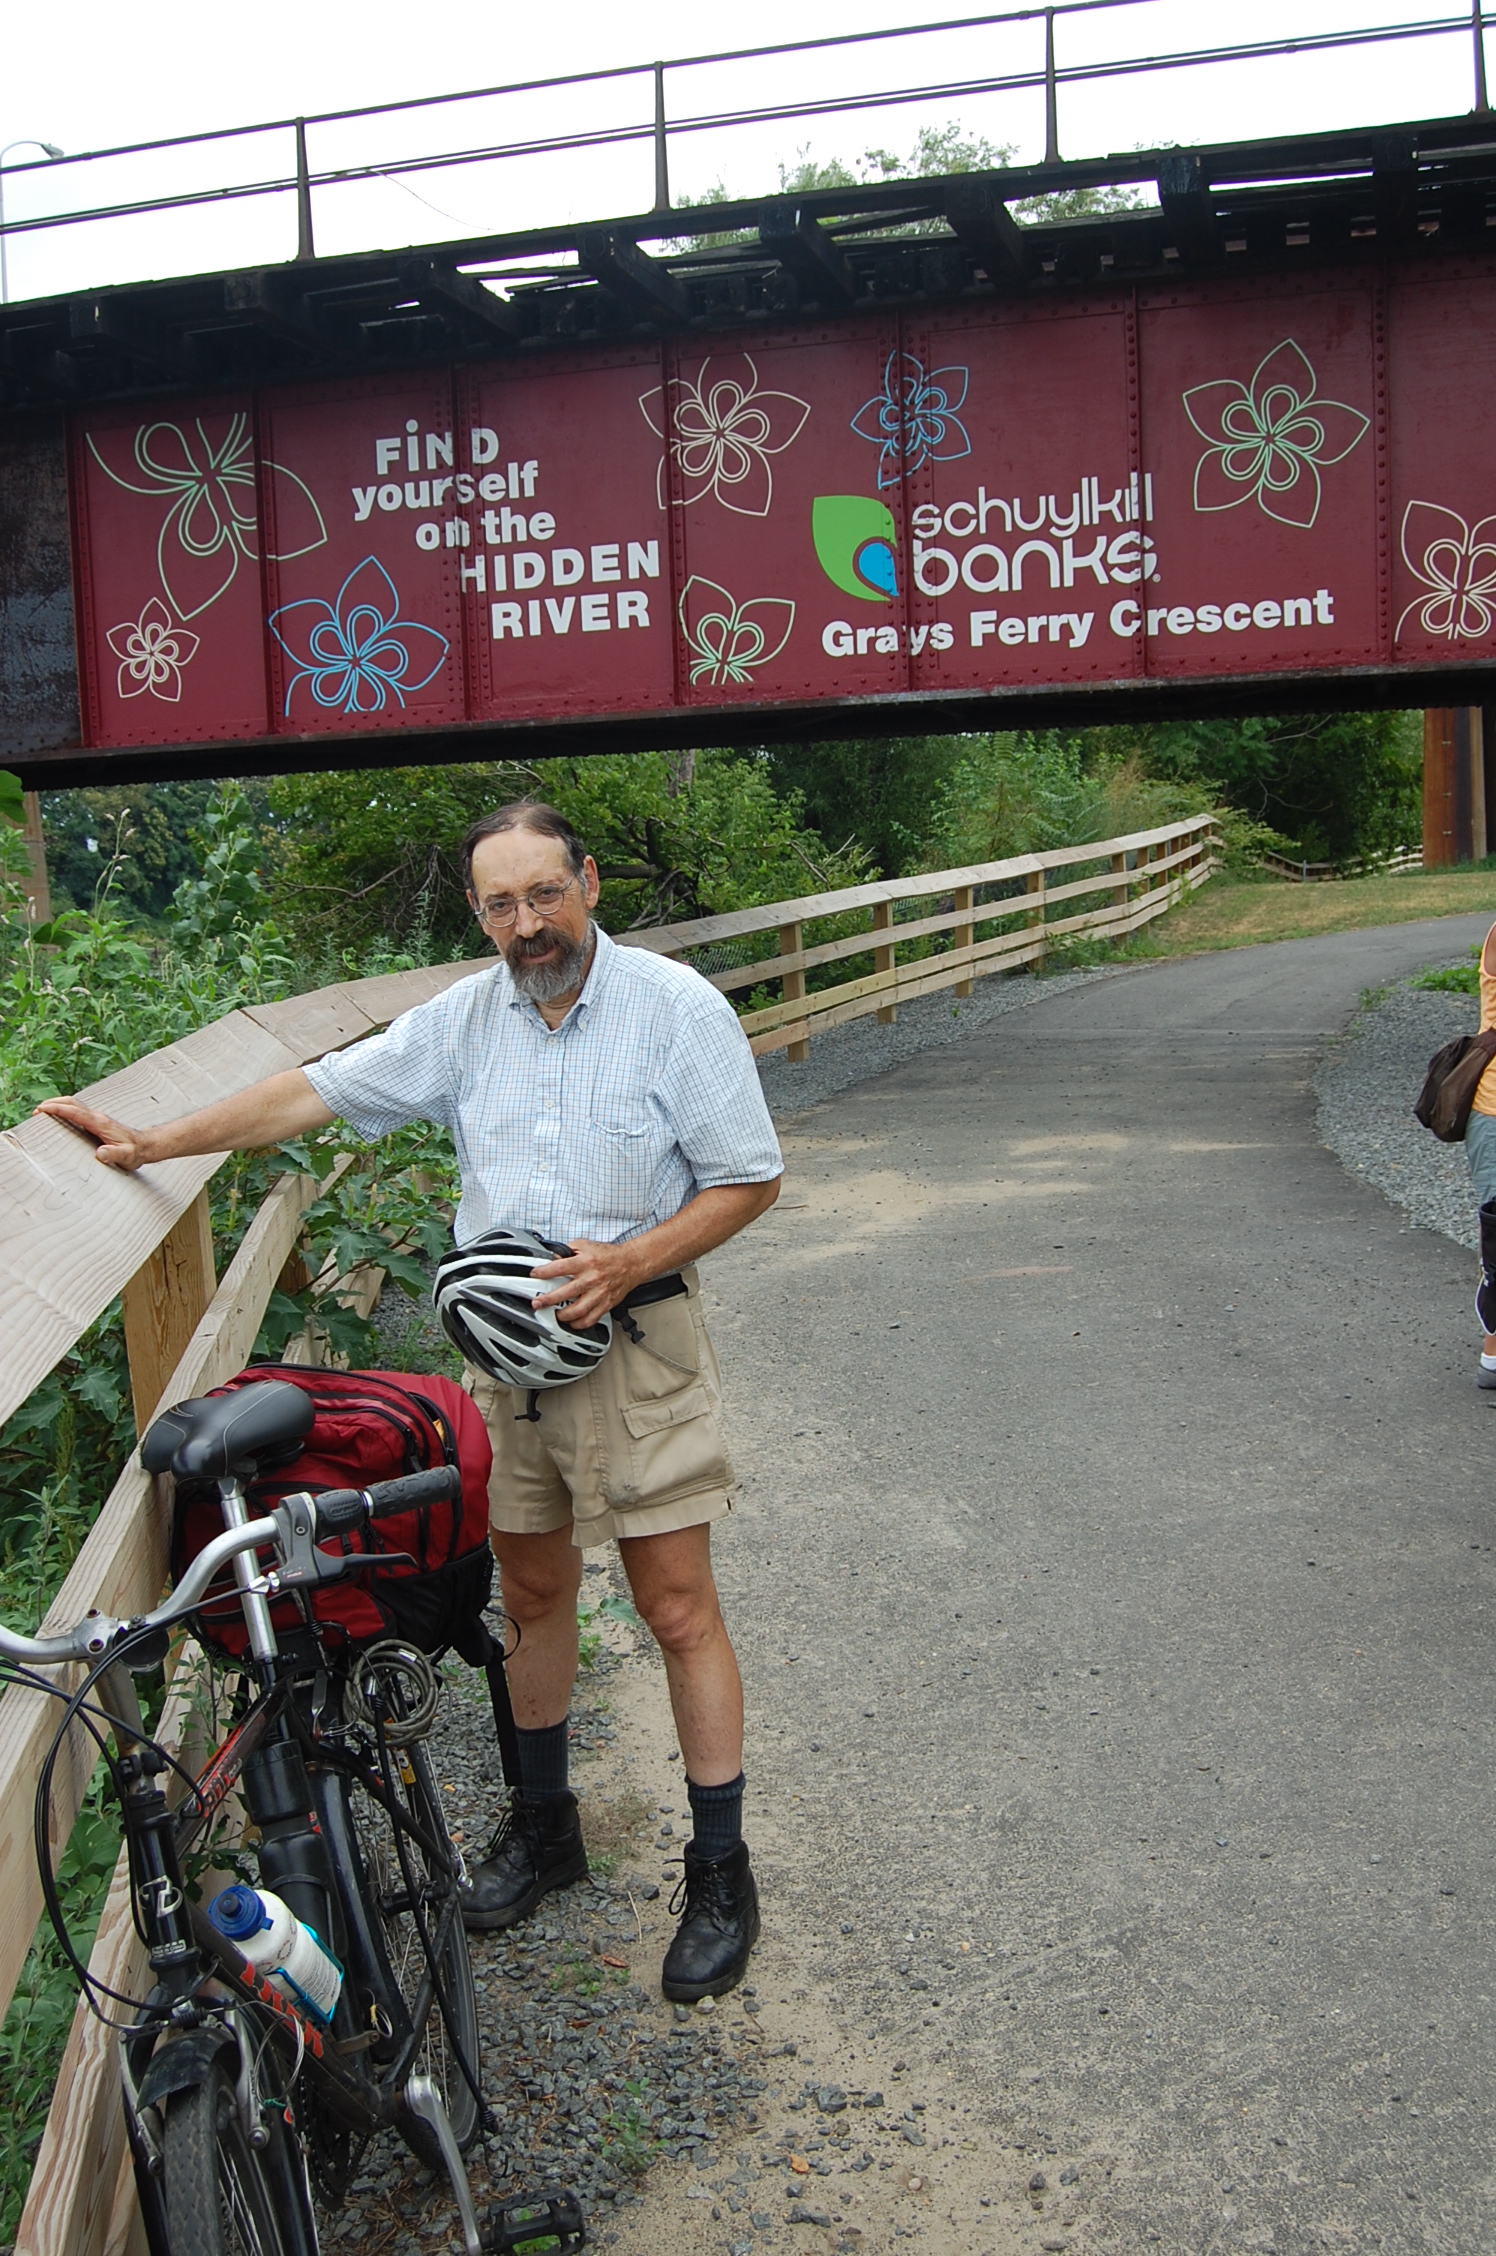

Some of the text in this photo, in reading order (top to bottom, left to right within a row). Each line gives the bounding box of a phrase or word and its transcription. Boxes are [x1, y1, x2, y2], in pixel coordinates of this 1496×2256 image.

[351, 459, 539, 522] yourself
[911, 471, 1154, 539] schuylkill
[415, 506, 556, 551] on the
[459, 539, 660, 593] HIDDEN
[491, 590, 651, 640] RIVER
[821, 589, 1335, 658] Grays Ferry Crescent
